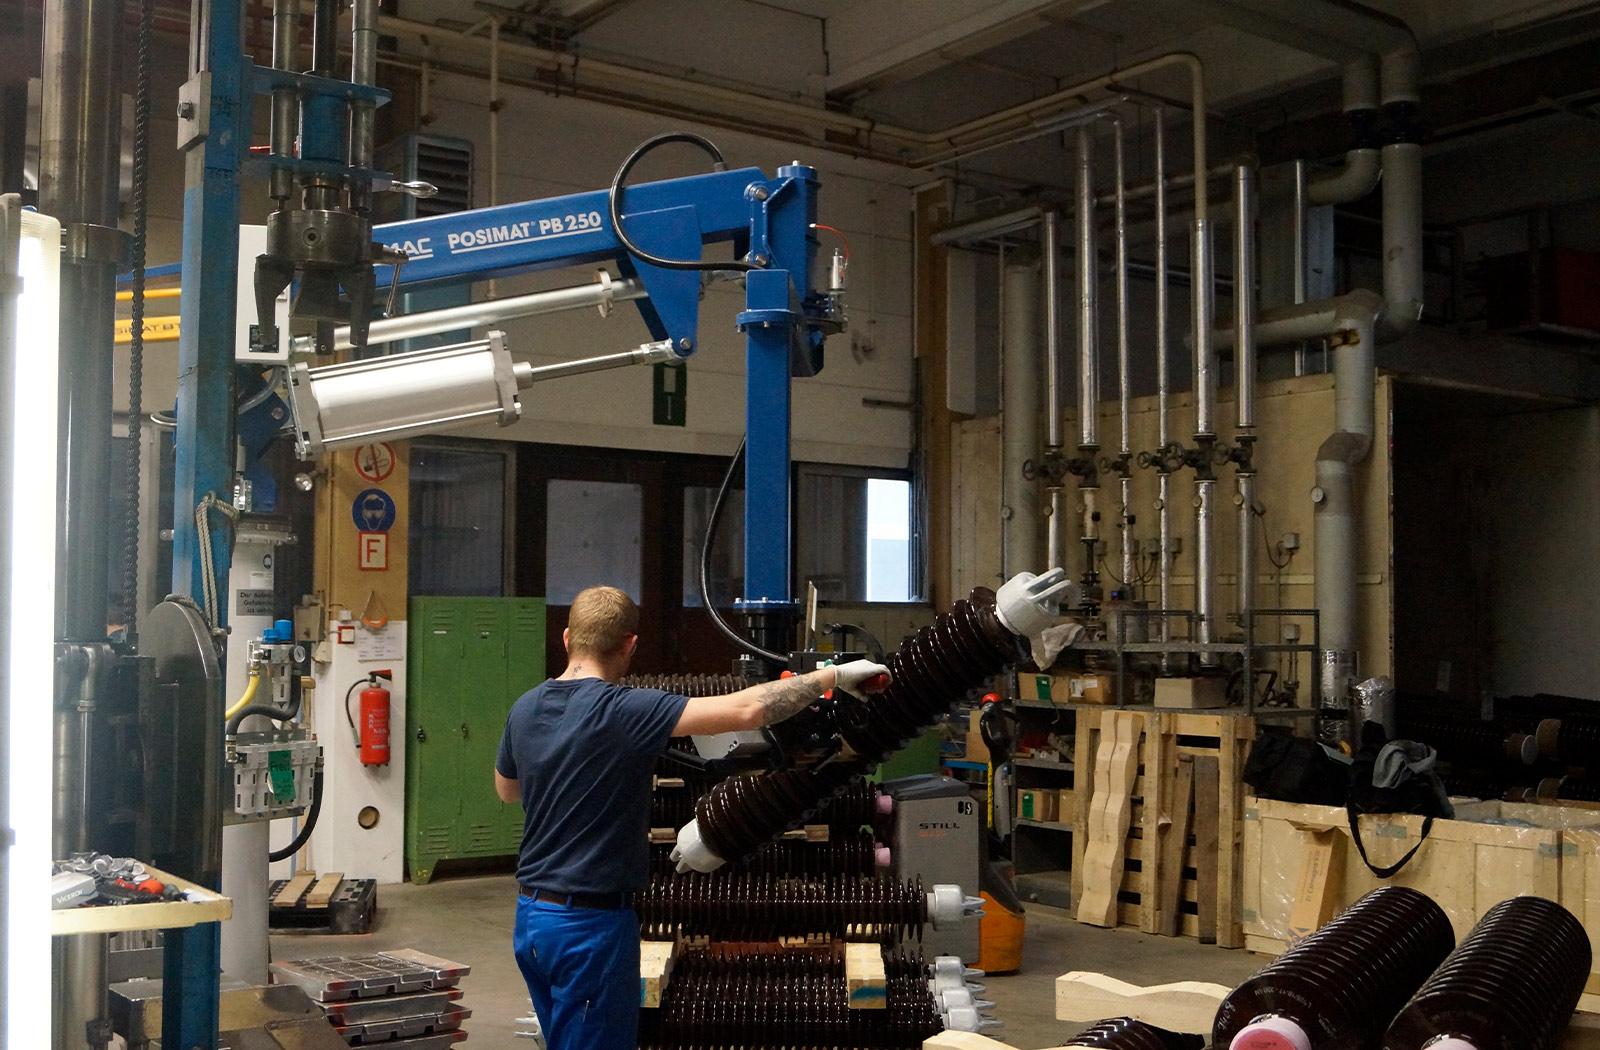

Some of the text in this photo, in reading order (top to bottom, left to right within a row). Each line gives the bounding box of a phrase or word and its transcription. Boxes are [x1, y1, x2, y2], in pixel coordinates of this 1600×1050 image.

[539, 217, 564, 235] PB
[565, 211, 601, 231] 250
[366, 538, 381, 563] F
[919, 822, 961, 830] STILL
